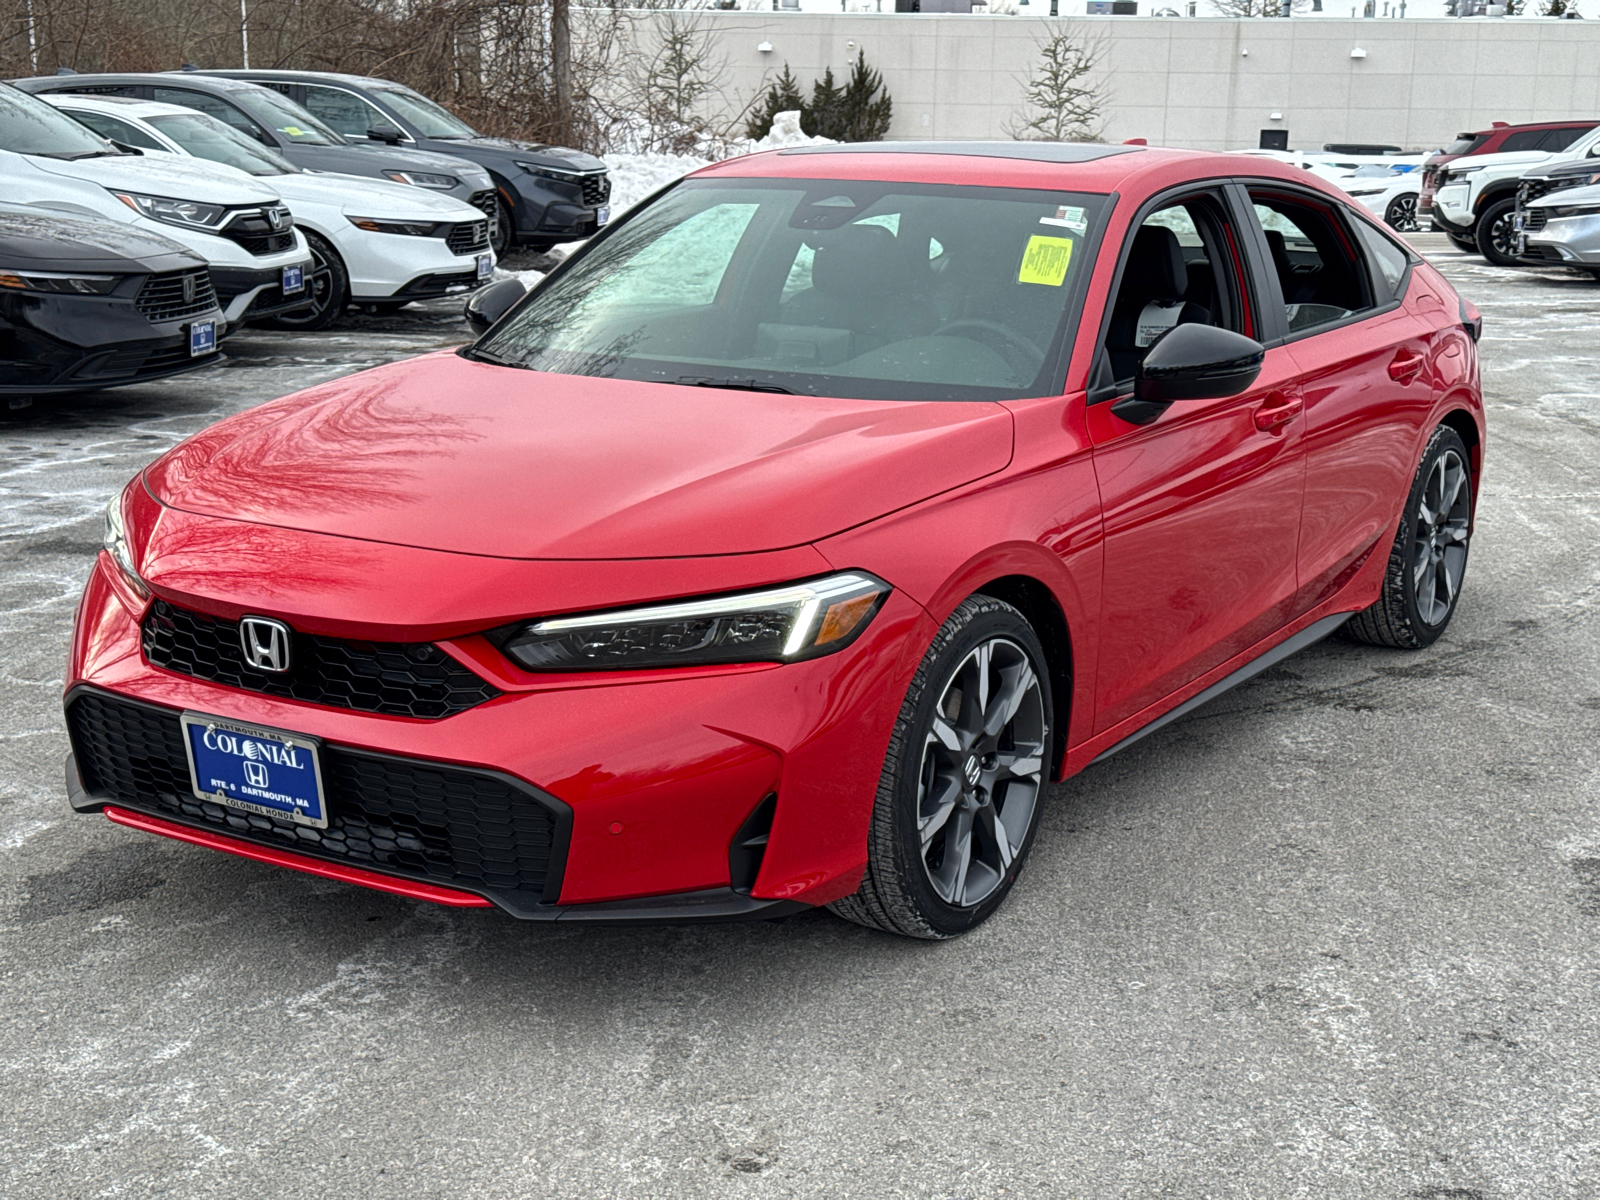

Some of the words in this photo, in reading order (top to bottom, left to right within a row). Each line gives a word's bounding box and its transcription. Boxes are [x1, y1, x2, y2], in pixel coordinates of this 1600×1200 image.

[213, 722, 268, 739] DARTMOUTH,
[203, 731, 304, 769] COLONIAL
[210, 778, 230, 790] RTE.
[230, 782, 236, 791] 6
[241, 785, 295, 806] DARTMOUTH,
[296, 798, 310, 808] MA
[226, 798, 265, 814] COLONIAL
[266, 808, 295, 821] HONDA
